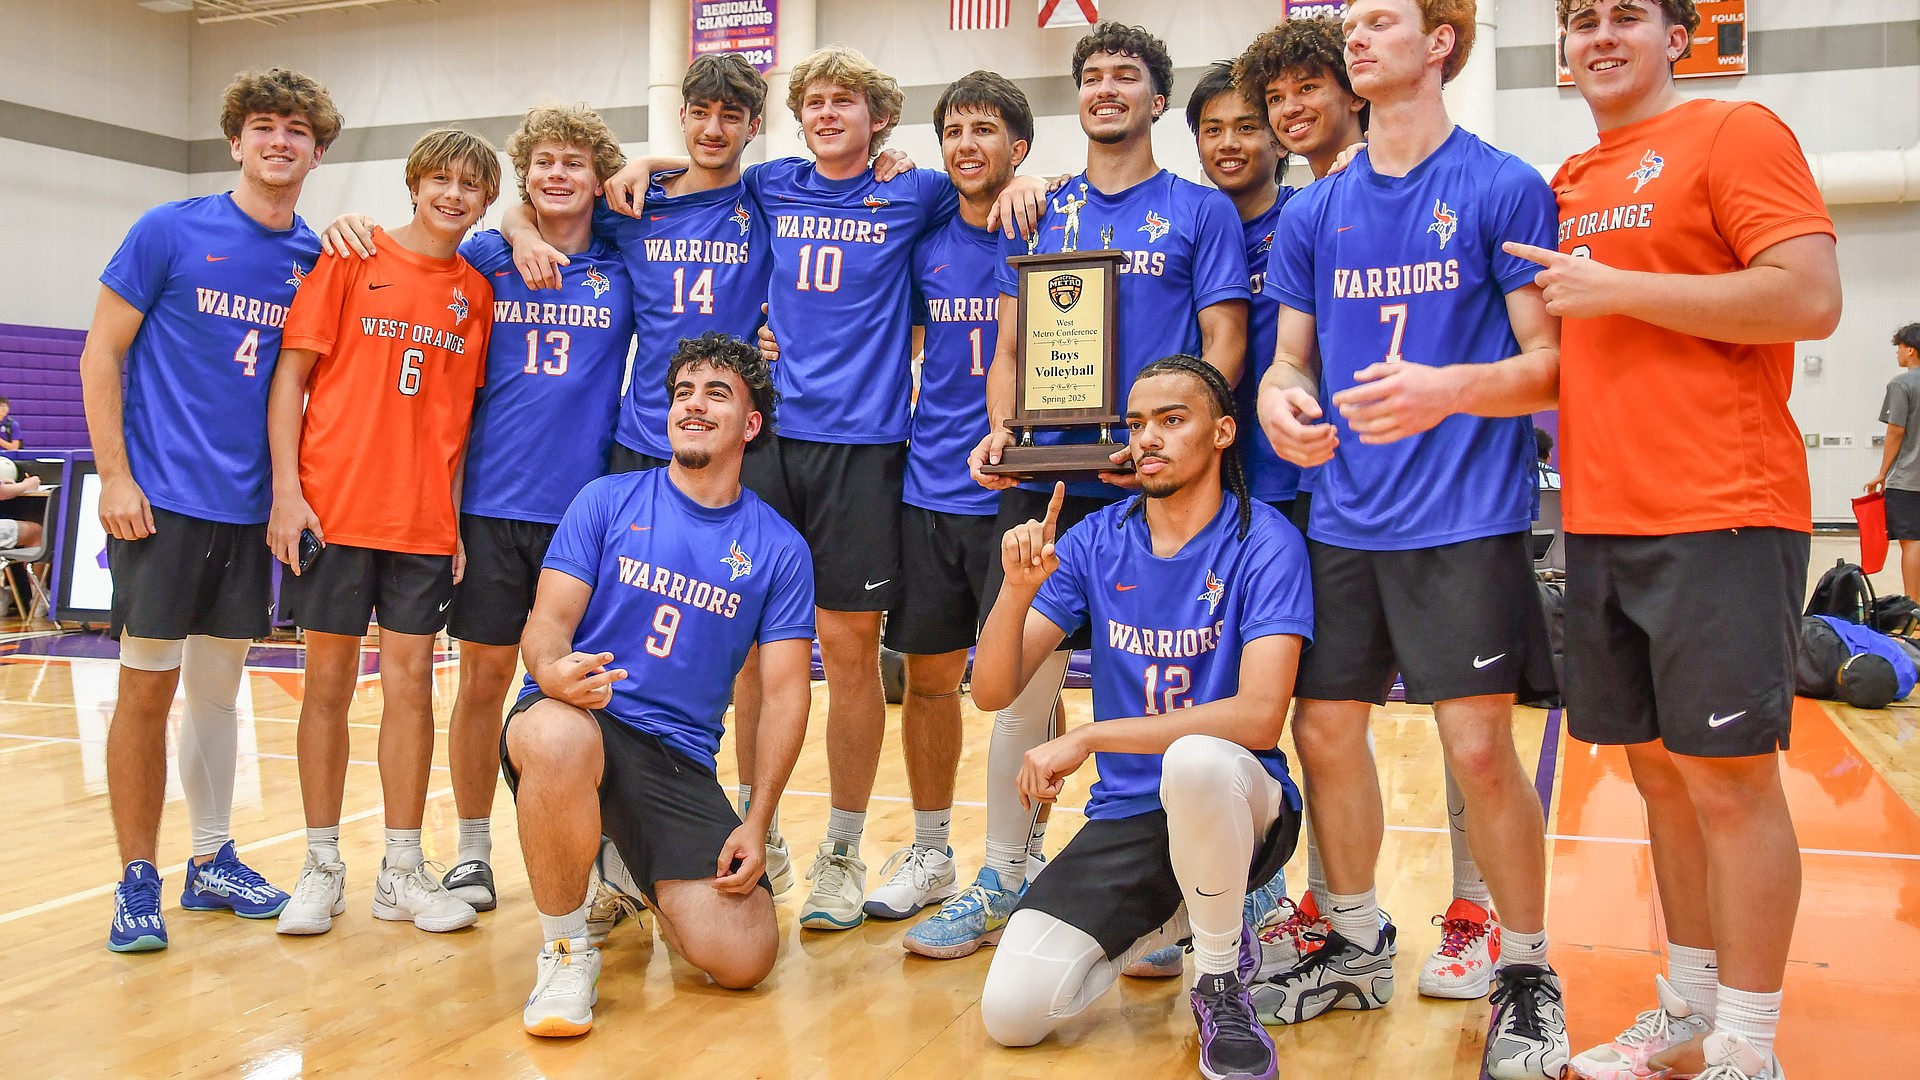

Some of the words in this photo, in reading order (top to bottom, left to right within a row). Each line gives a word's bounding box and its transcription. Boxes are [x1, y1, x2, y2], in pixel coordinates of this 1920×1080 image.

[696, 11, 773, 30] CHAMPIONS
[702, 0, 767, 17] REGIONAL
[1290, 4, 1348, 19] 2023-2
[1711, 13, 1744, 23] FOULS
[1718, 56, 1744, 65] WON
[776, 215, 888, 244] WARRIORS
[1577, 203, 1654, 237] ORANGE
[644, 239, 749, 264] WARRIORS
[796, 244, 844, 292] 10
[1333, 259, 1459, 299] WARRIORS
[672, 266, 714, 315] 14
[1050, 279, 1081, 289] METRO
[493, 301, 611, 328] WARRIORS
[1056, 319, 1074, 327] West
[361, 317, 409, 340] WEST
[411, 324, 465, 355] ORANGE
[1032, 330, 1055, 338] Metro
[1056, 328, 1098, 337] Conference
[1380, 303, 1408, 363] 7
[234, 328, 260, 377] 4
[523, 329, 571, 376] 13
[969, 327, 985, 376] 1
[1051, 350, 1079, 363] Boys
[398, 347, 424, 396] 6
[1035, 364, 1094, 379] Volleyball
[1042, 395, 1066, 404] Spring
[1068, 394, 1086, 402] 2025
[618, 555, 741, 619] WARRIORS
[644, 603, 682, 659] 9
[1144, 664, 1194, 715] 12
